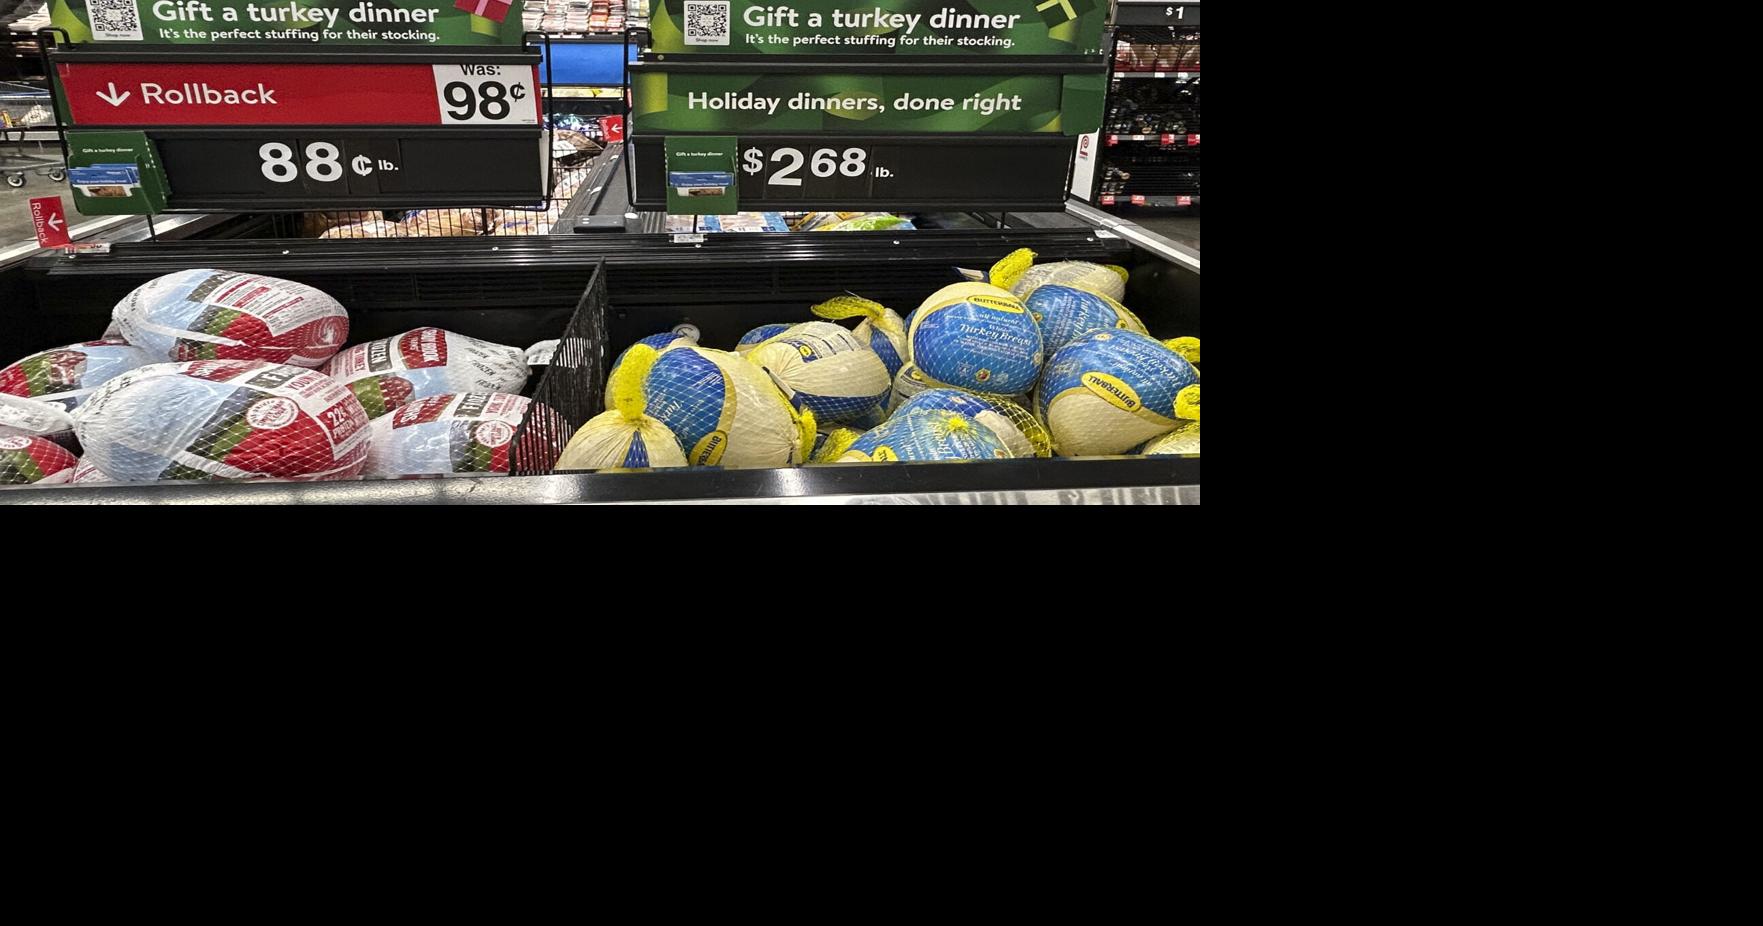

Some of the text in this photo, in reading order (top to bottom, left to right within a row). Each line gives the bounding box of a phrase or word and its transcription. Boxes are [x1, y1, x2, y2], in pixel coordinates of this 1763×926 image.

[152, 0, 440, 28] Gift a turkey dinner
[743, 5, 1021, 34] Gift a turkey dinner
[1166, 6, 1184, 19] $1
[159, 28, 440, 42] It's the perfect stuffing for their stocking.
[745, 34, 1015, 48] It's the perfect stuffing for their stocking.
[460, 64, 501, 76] Was:
[140, 83, 277, 104] Rollback
[443, 81, 526, 121] 98¢
[688, 92, 1022, 115] Holiday dinners, done right
[377, 159, 399, 171] lb.
[875, 166, 894, 178] lb.
[31, 202, 49, 244] Rollback
[960, 323, 1000, 340] Turkey
[1088, 375, 1136, 409] BUTTERBALL
